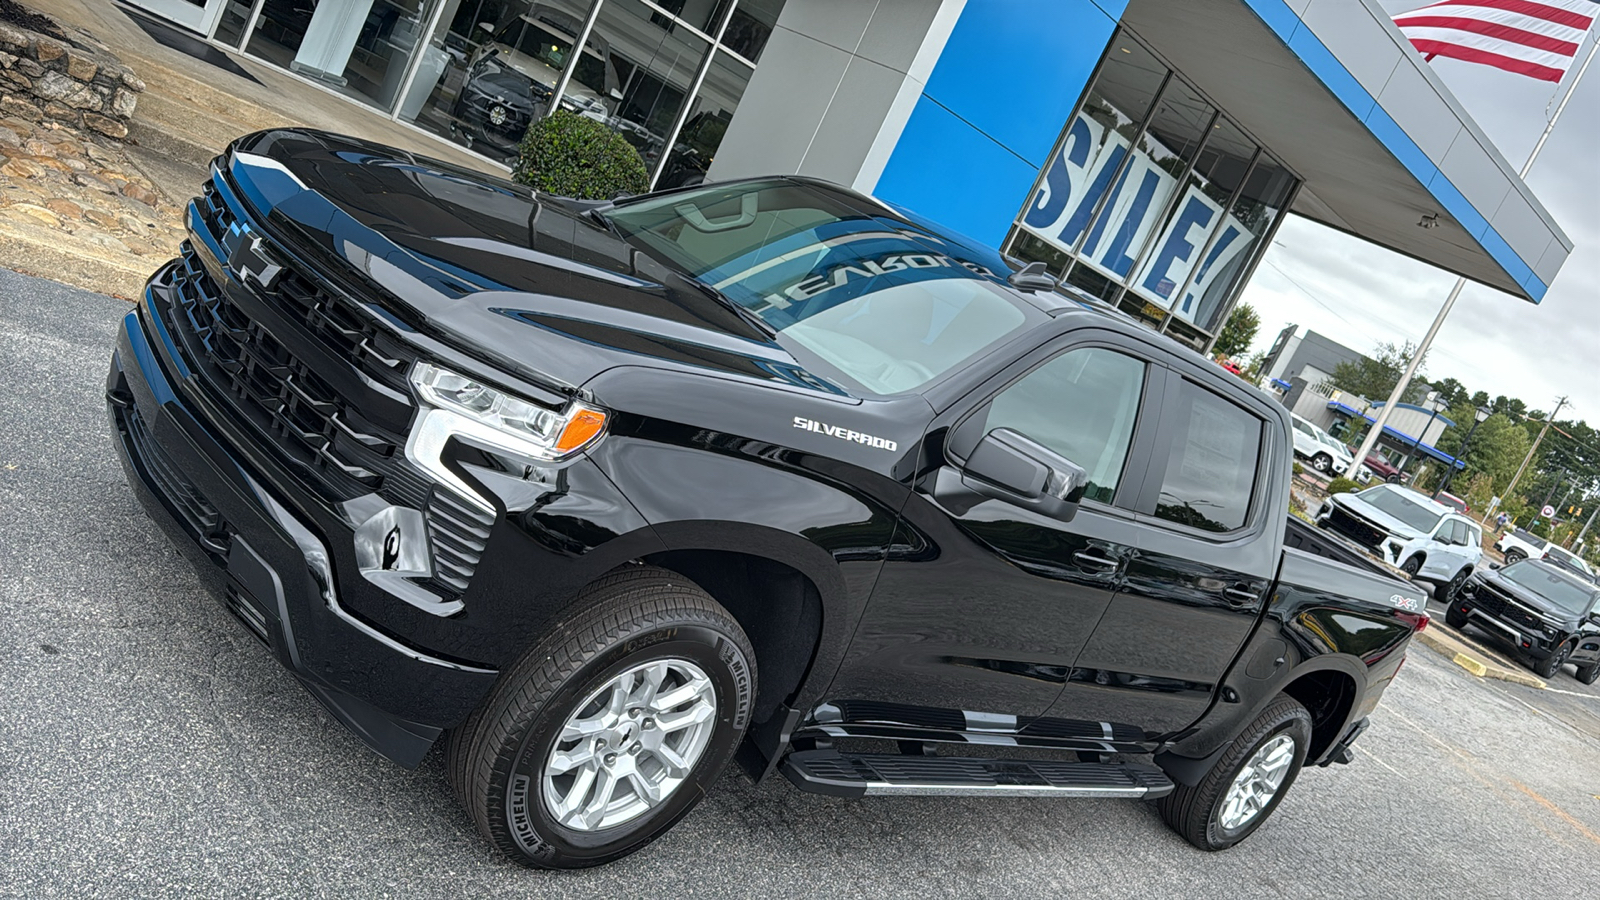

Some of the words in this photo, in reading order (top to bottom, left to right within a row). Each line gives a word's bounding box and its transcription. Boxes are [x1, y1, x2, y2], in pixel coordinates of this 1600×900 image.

[1024, 116, 1241, 314] SALE!
[793, 416, 898, 452] SILVERADO
[731, 660, 748, 726] MICHELIN
[513, 778, 540, 848] MICHELIN
